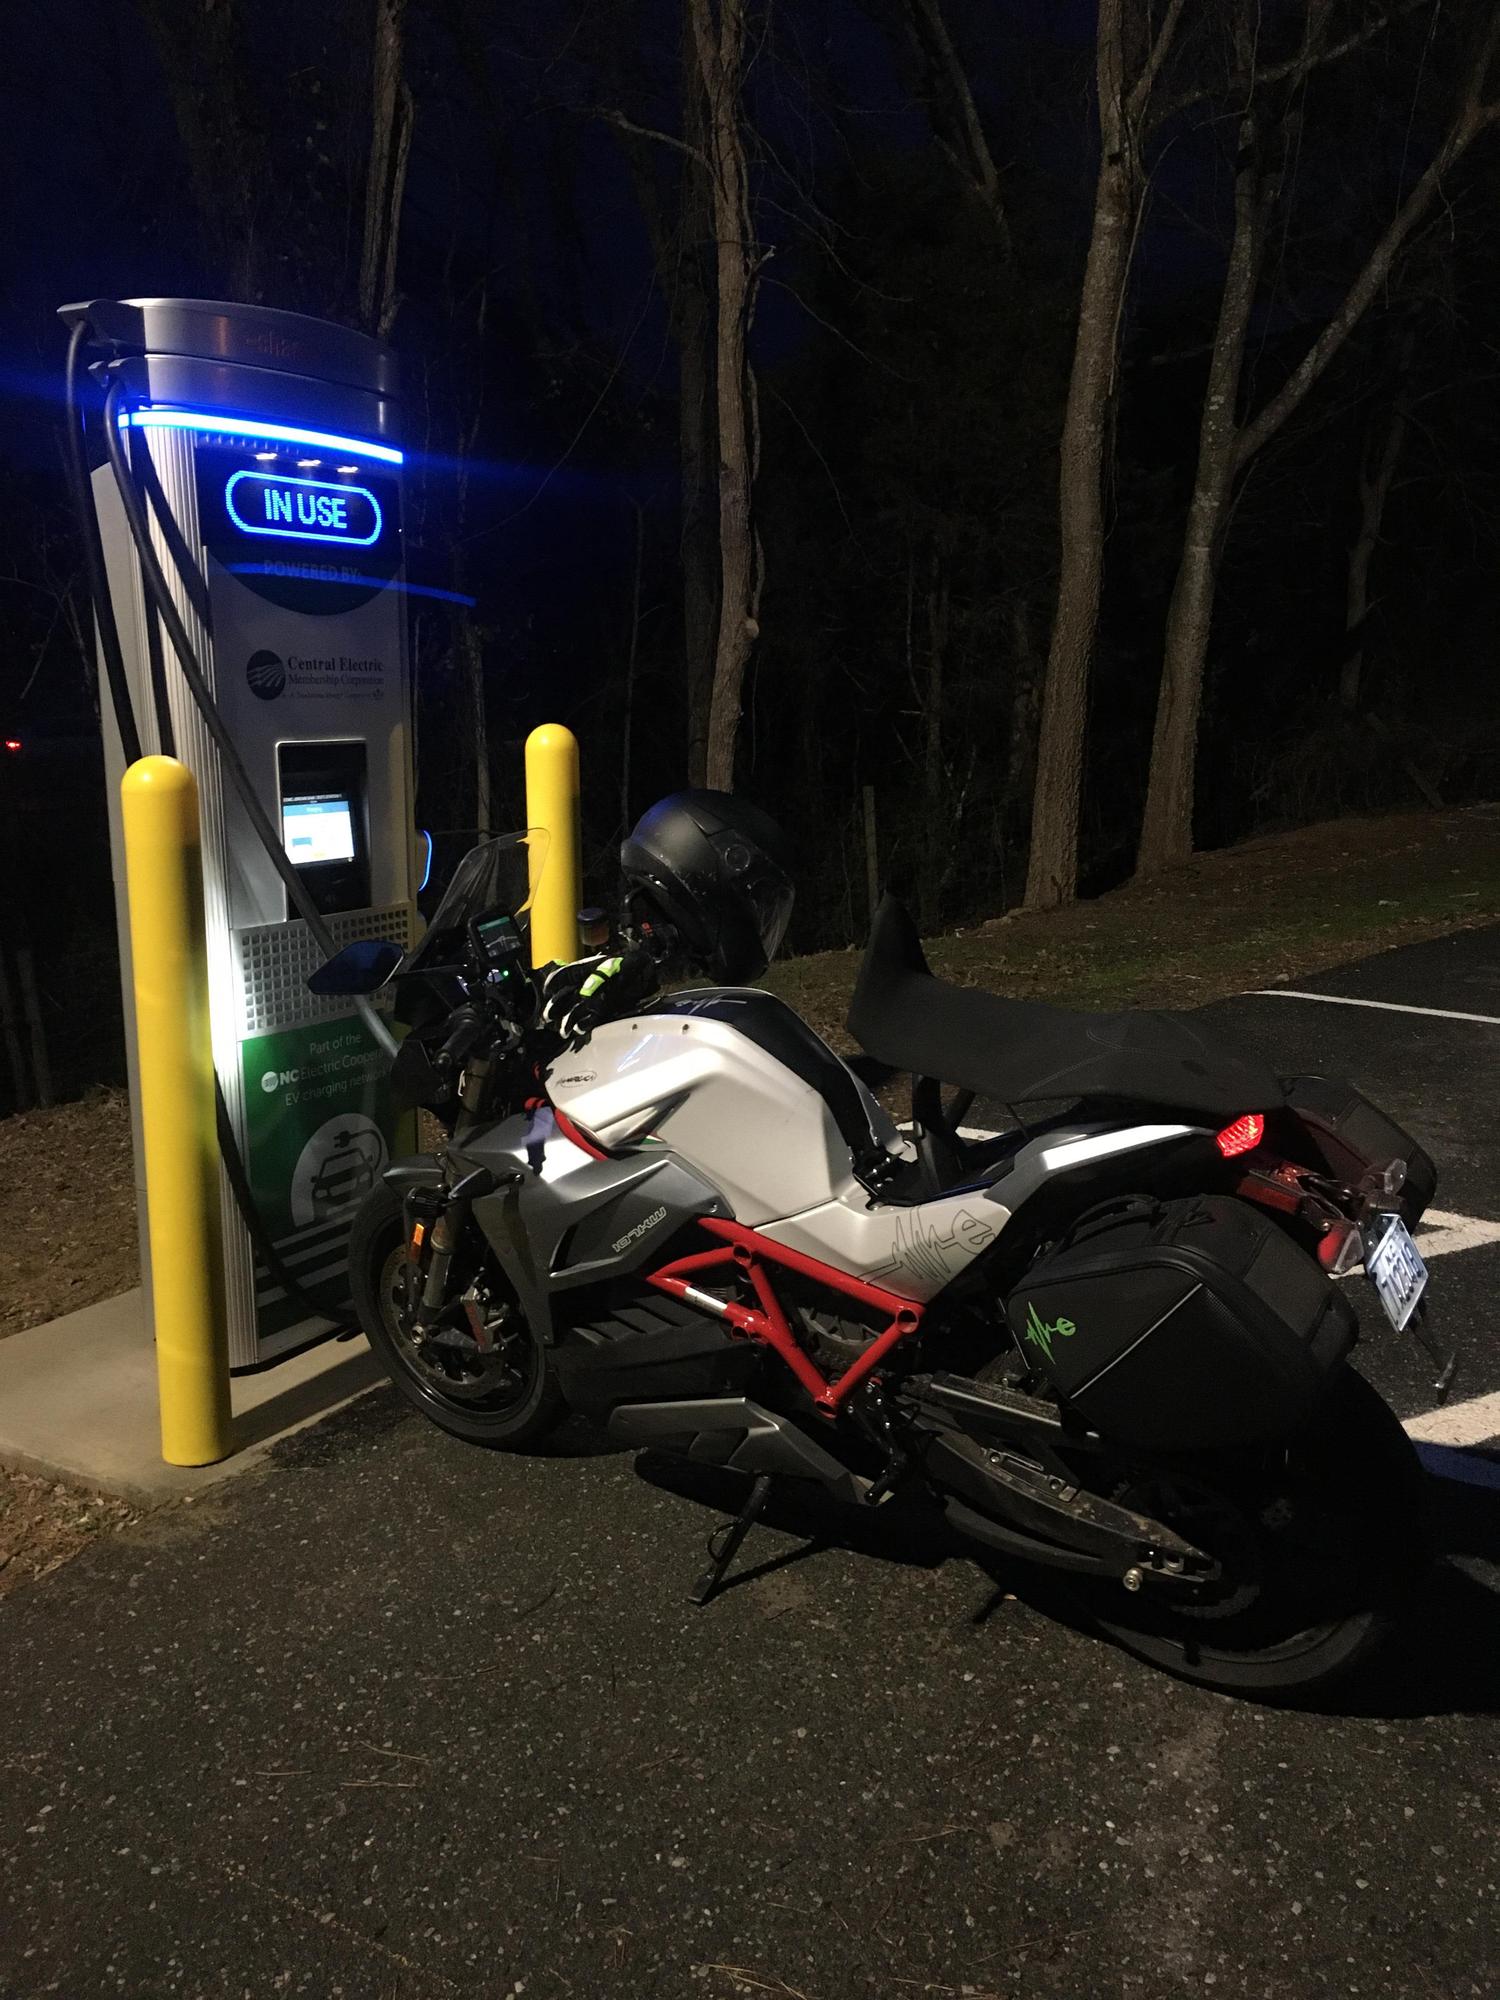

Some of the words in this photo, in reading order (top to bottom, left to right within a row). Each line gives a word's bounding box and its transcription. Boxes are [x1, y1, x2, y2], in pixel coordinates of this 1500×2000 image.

[263, 488, 293, 522] IN
[296, 492, 348, 530] USE
[263, 559, 338, 581] POWERED
[287, 655, 336, 672] Central
[339, 657, 384, 673] Electric
[309, 1040, 331, 1056] Part
[332, 1036, 344, 1050] of
[344, 1033, 362, 1048] the
[279, 1068, 300, 1086] NC
[300, 1058, 341, 1081] Electric
[285, 1092, 300, 1107] EV
[302, 1079, 348, 1099] charging
